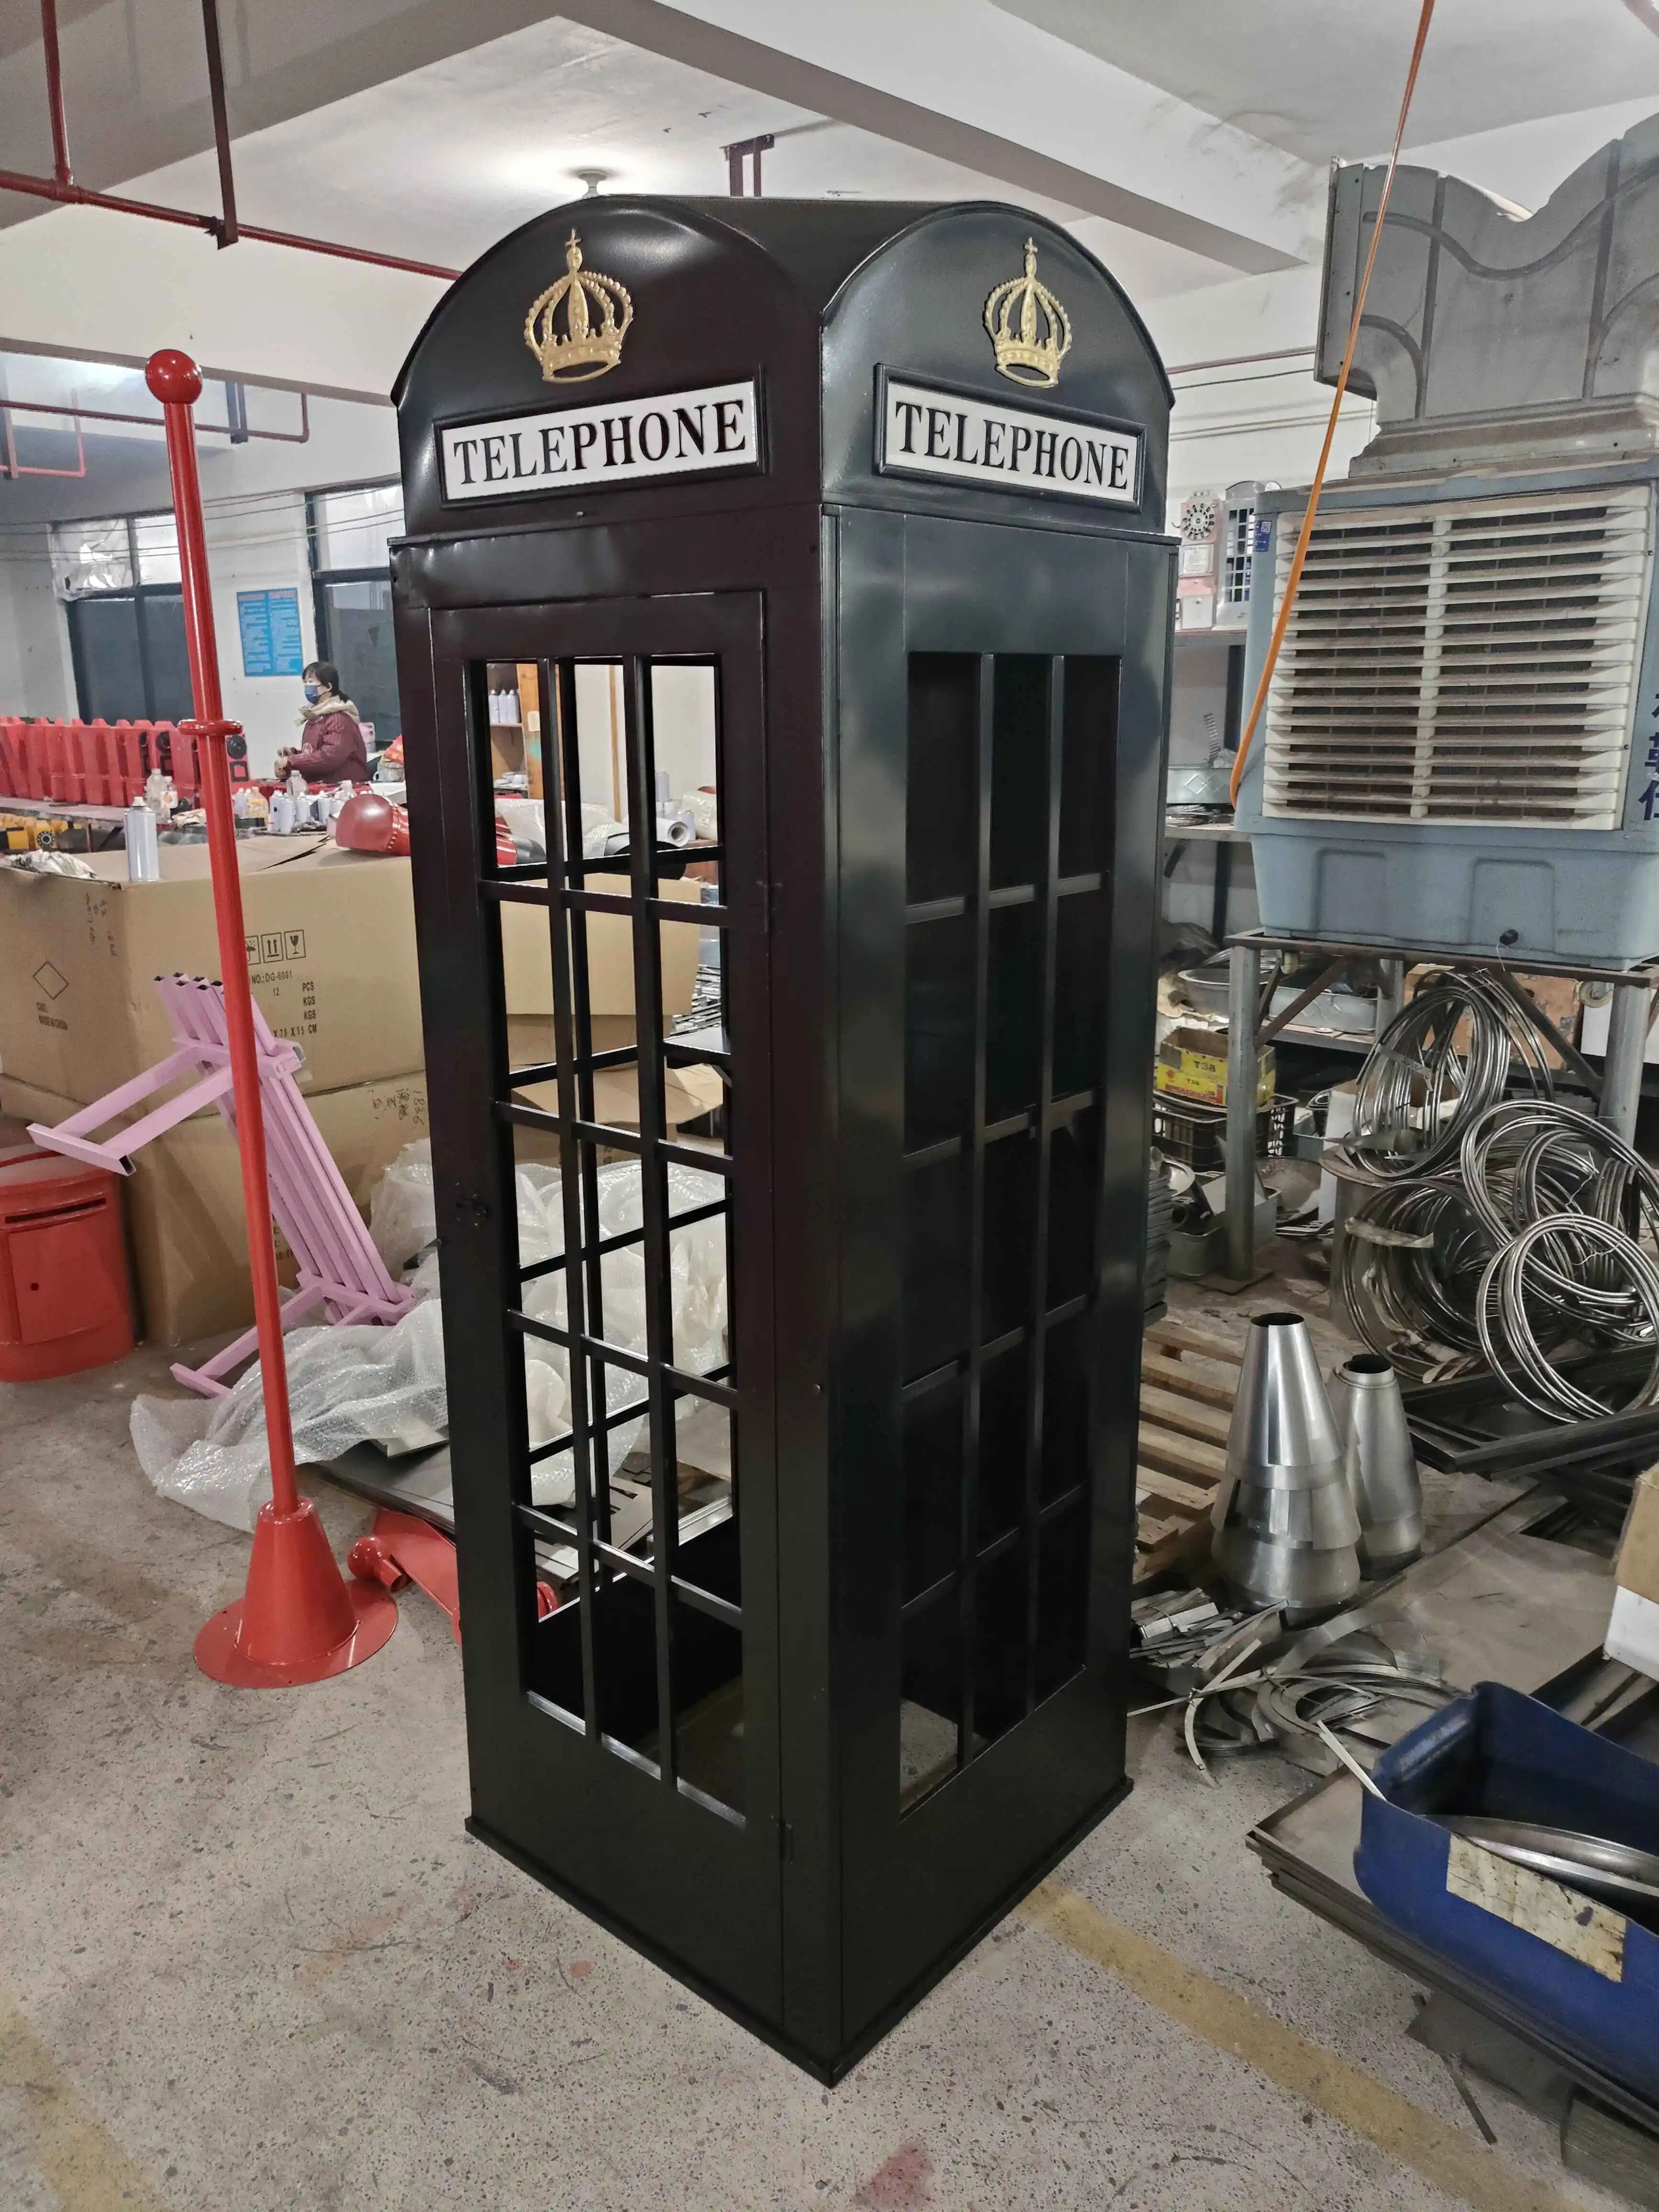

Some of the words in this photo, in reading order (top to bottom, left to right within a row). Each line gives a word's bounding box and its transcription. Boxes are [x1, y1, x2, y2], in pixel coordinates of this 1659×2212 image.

[453, 399, 746, 485] TELEPHONE
[896, 401, 1129, 490] TELEPHONE
[272, 987, 280, 996] 12
[302, 981, 314, 992] PCS
[303, 996, 315, 1006] KGS
[304, 1010, 316, 1020] KGS
[308, 1024, 317, 1034] CM
[1194, 1061, 1216, 1072] T38
